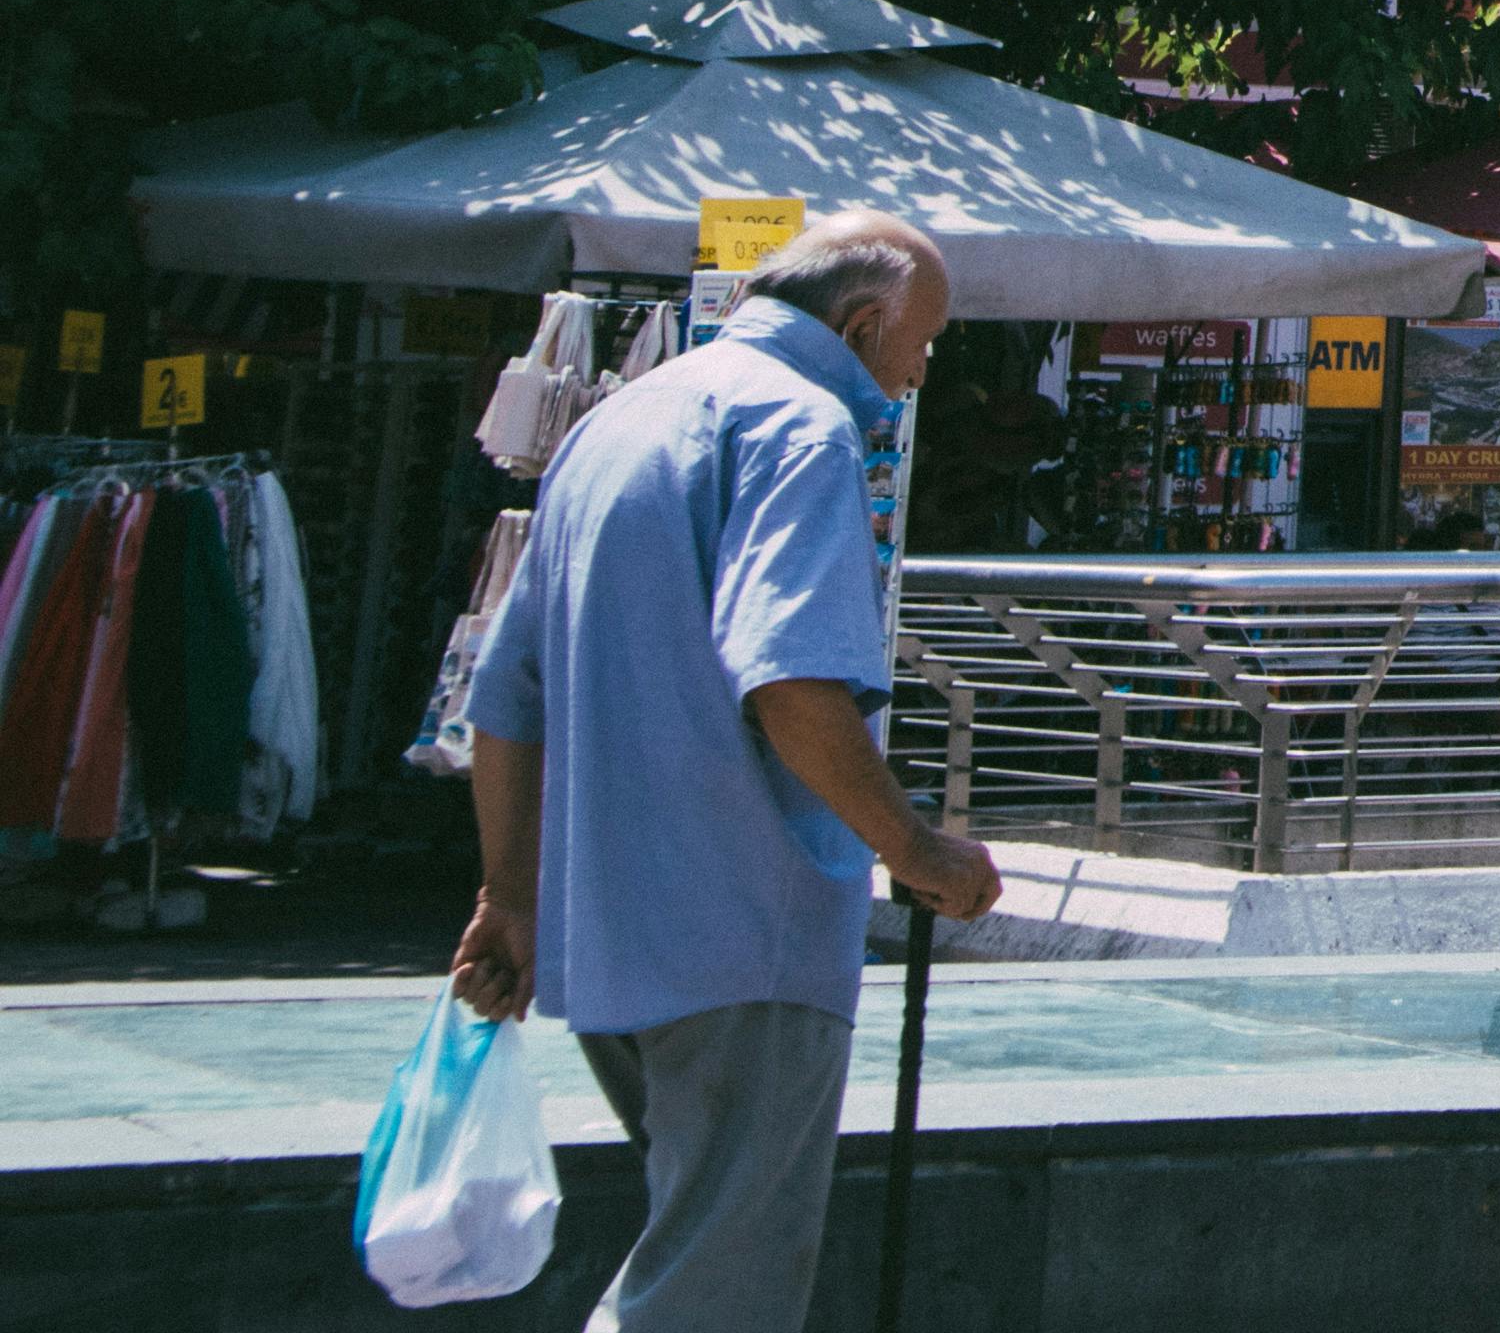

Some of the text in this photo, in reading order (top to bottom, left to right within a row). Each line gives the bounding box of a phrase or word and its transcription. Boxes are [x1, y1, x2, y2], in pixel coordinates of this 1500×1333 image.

[1309, 340, 1381, 372] ATM
[1409, 451, 1417, 465] 1
[1425, 451, 1460, 465] DAY
